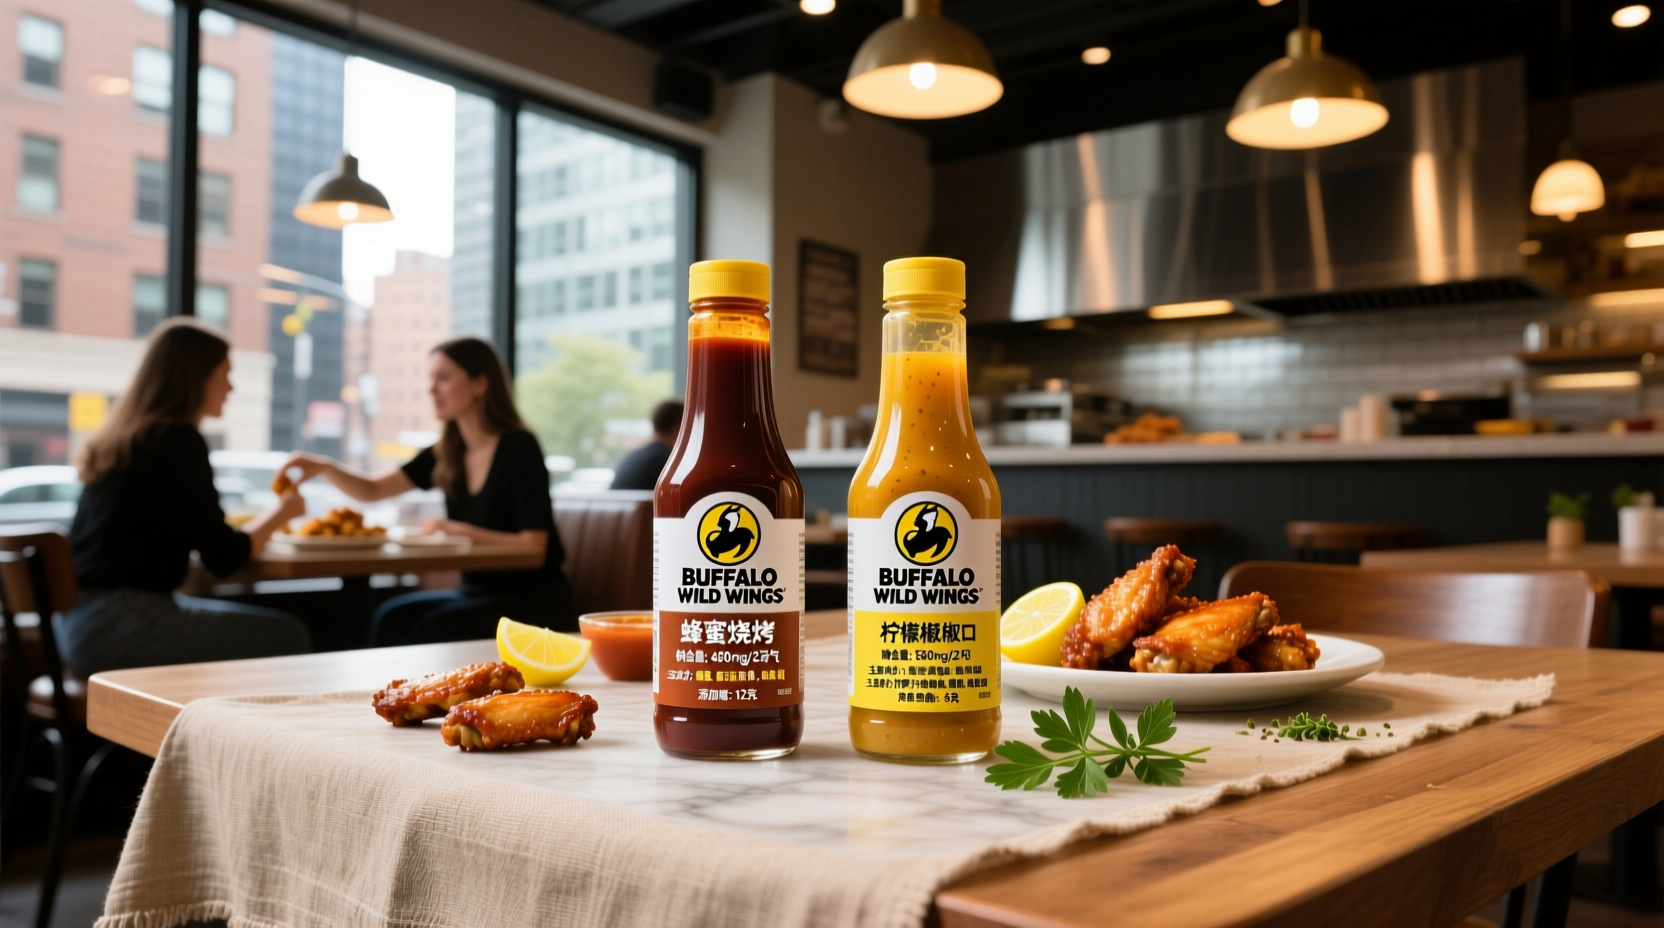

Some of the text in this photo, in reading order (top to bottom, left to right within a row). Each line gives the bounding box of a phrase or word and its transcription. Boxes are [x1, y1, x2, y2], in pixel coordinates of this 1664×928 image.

[682, 567, 778, 587] BUFFALO
[879, 567, 975, 587] BUFFALO
[677, 587, 721, 604] WILD
[873, 587, 917, 605] WILD
[680, 618, 776, 645] 蜂蜜烧烤
